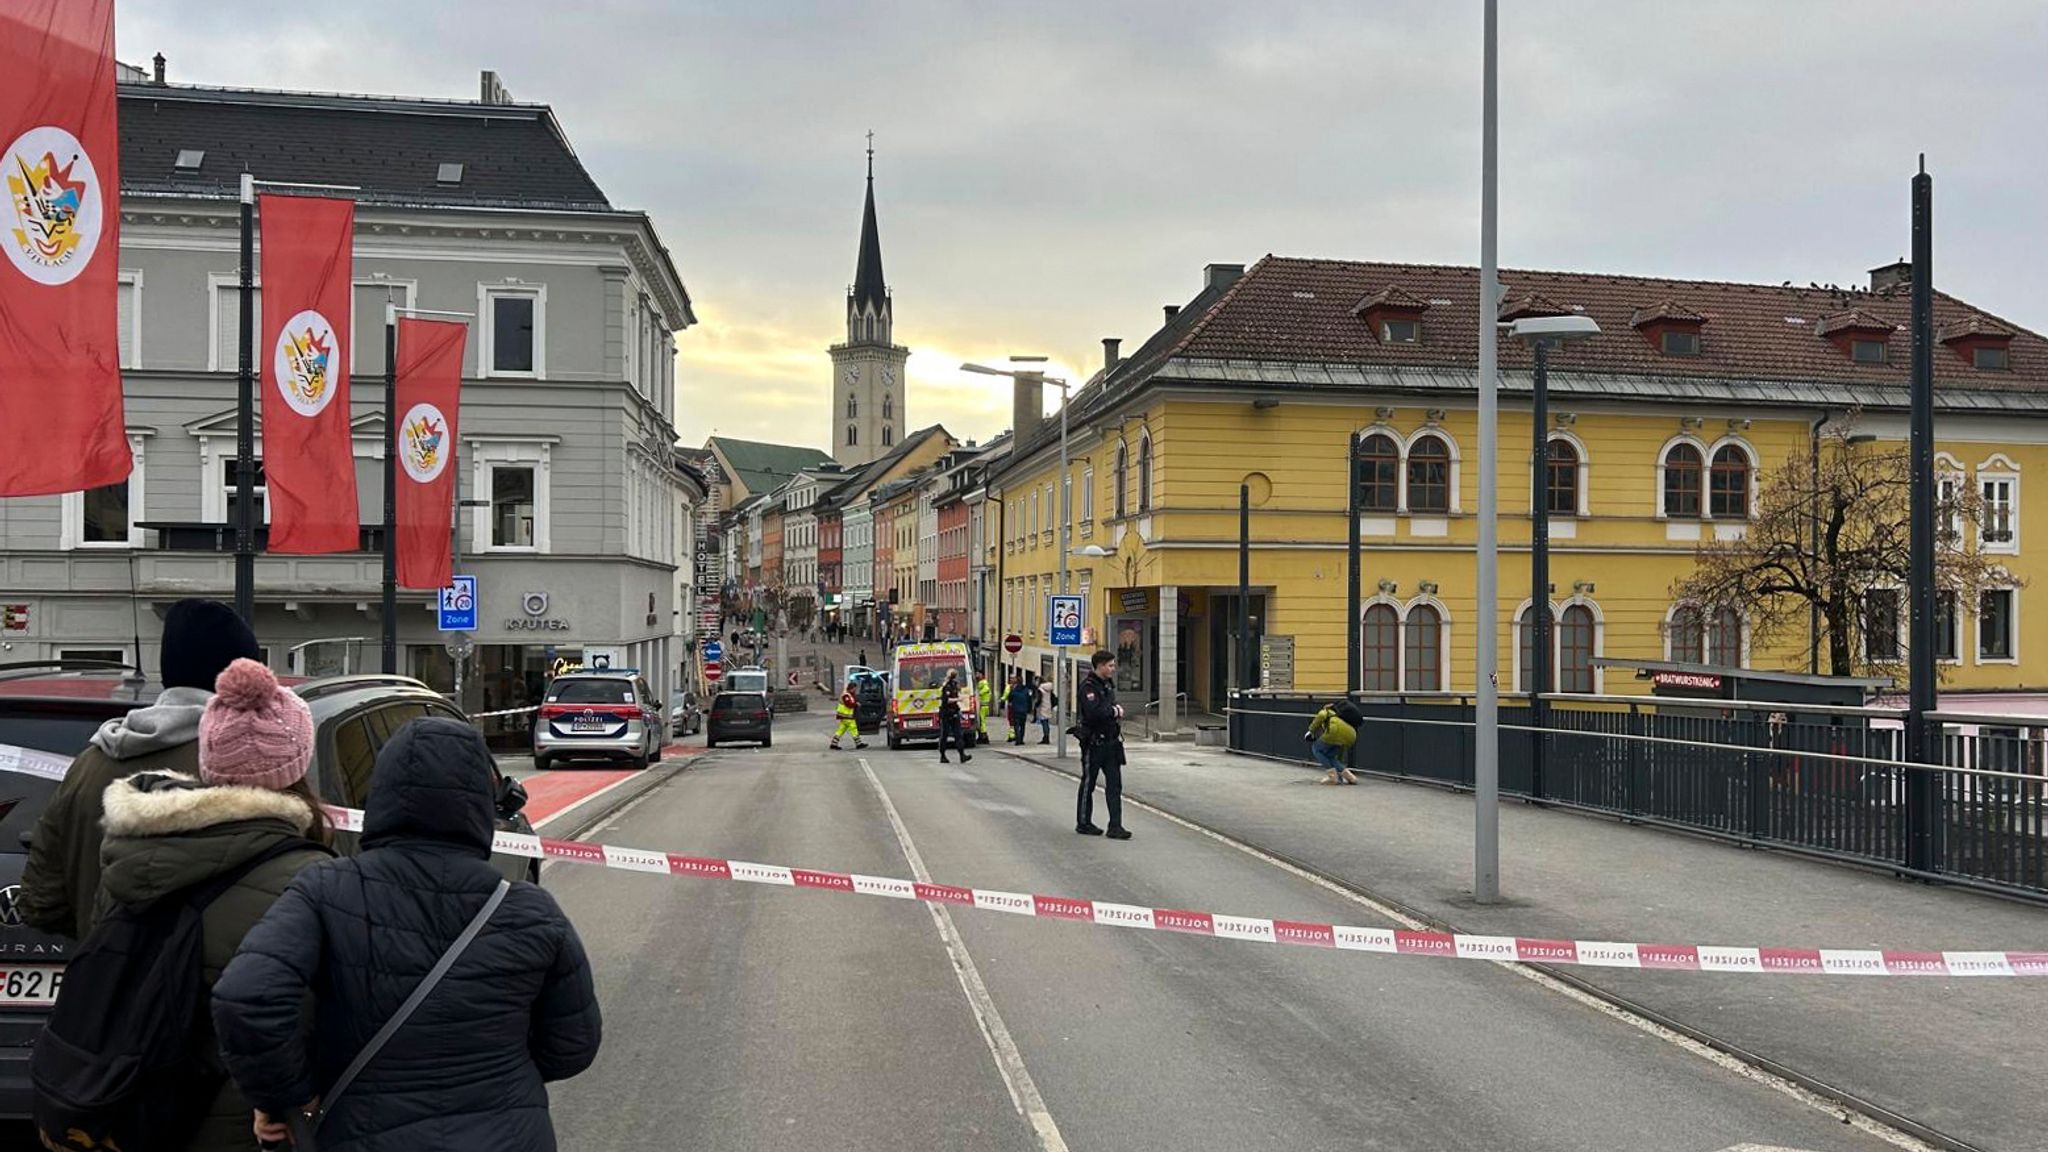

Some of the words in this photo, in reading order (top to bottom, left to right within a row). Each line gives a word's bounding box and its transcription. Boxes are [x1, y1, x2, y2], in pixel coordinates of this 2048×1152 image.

[26, 247, 73, 267] VILLACH
[697, 541, 706, 596] HOTEL
[460, 599, 470, 608] 20
[446, 615, 469, 624] Zone
[1068, 617, 1078, 626] 20
[505, 619, 570, 630] KYUTEA
[1055, 631, 1076, 640] Zone
